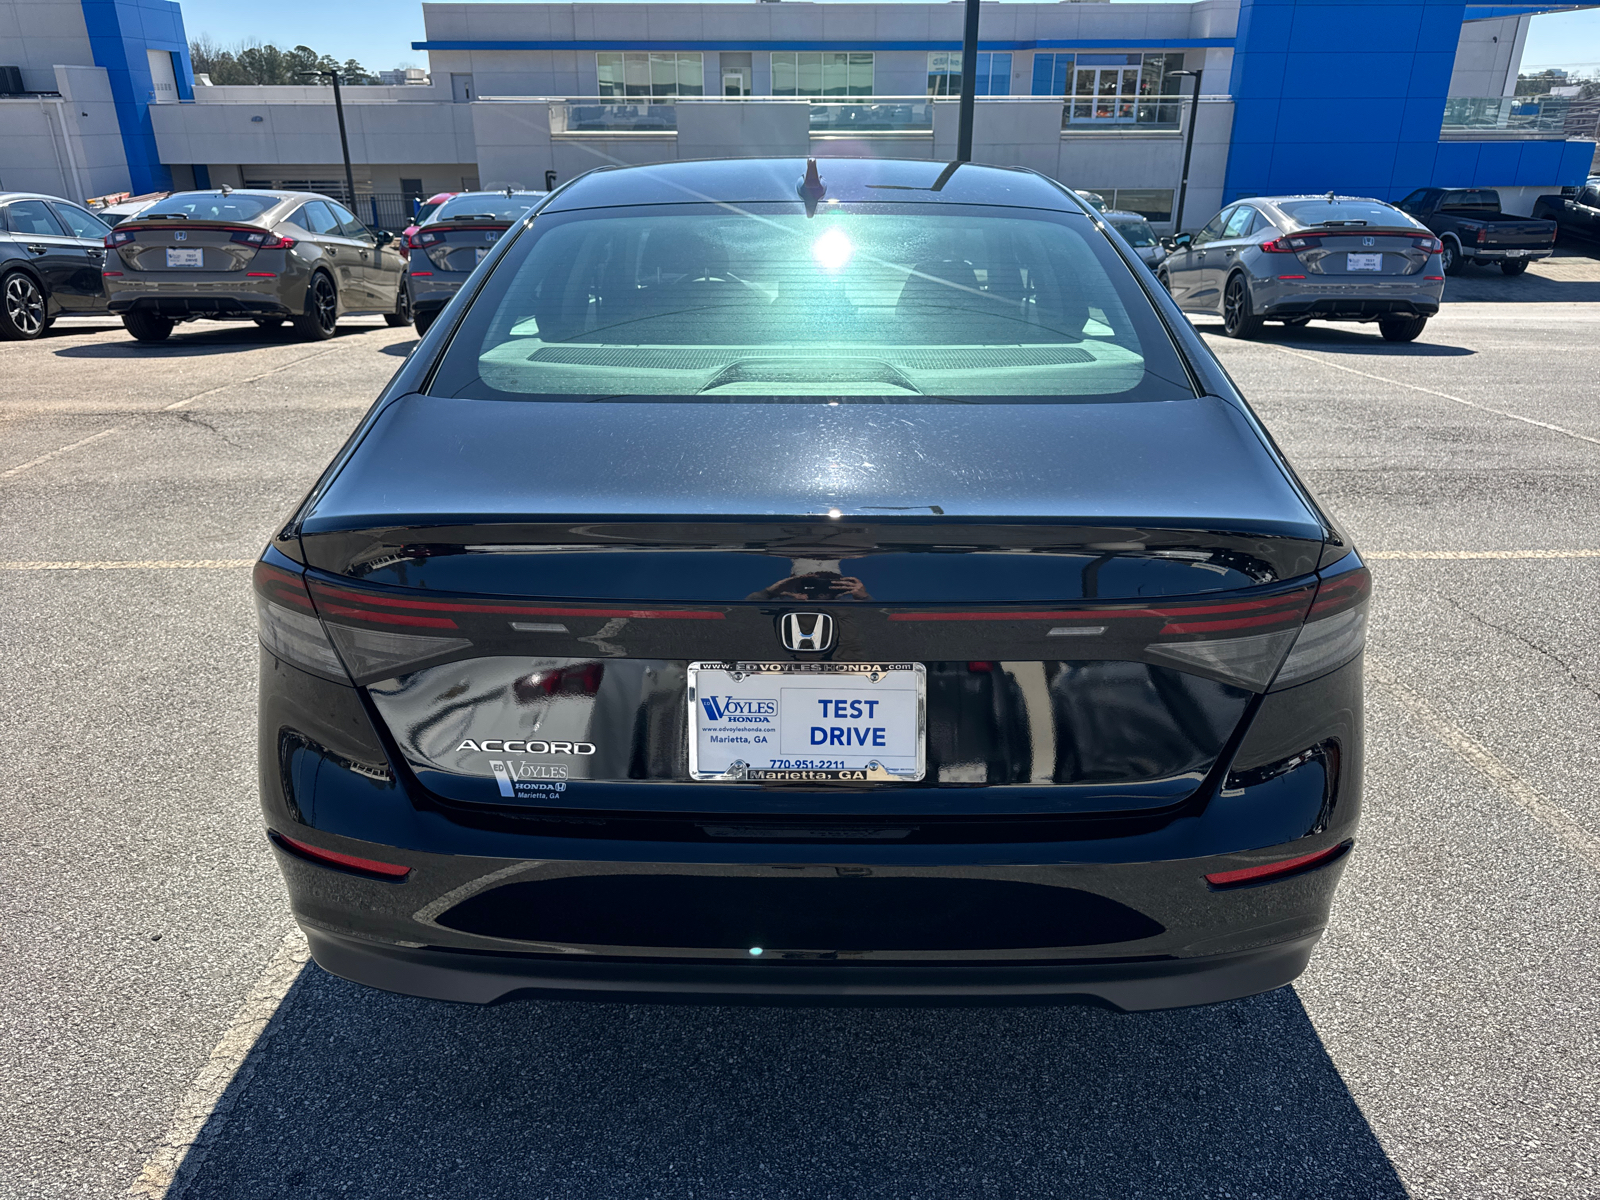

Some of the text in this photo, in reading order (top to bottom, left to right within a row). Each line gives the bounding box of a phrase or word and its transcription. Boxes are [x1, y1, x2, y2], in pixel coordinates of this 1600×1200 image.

[710, 695, 775, 719] VOYLES
[817, 699, 880, 719] TEST
[710, 735, 768, 744] Marietta, GA
[810, 726, 886, 747] DRIVE
[455, 739, 597, 755] ACCORD
[769, 759, 845, 769] 770-951-2211
[493, 760, 567, 782] ED VOYLES
[750, 770, 865, 780] Marietta, GA
[514, 783, 555, 791] HONDA
[517, 791, 548, 800] Marietta,
